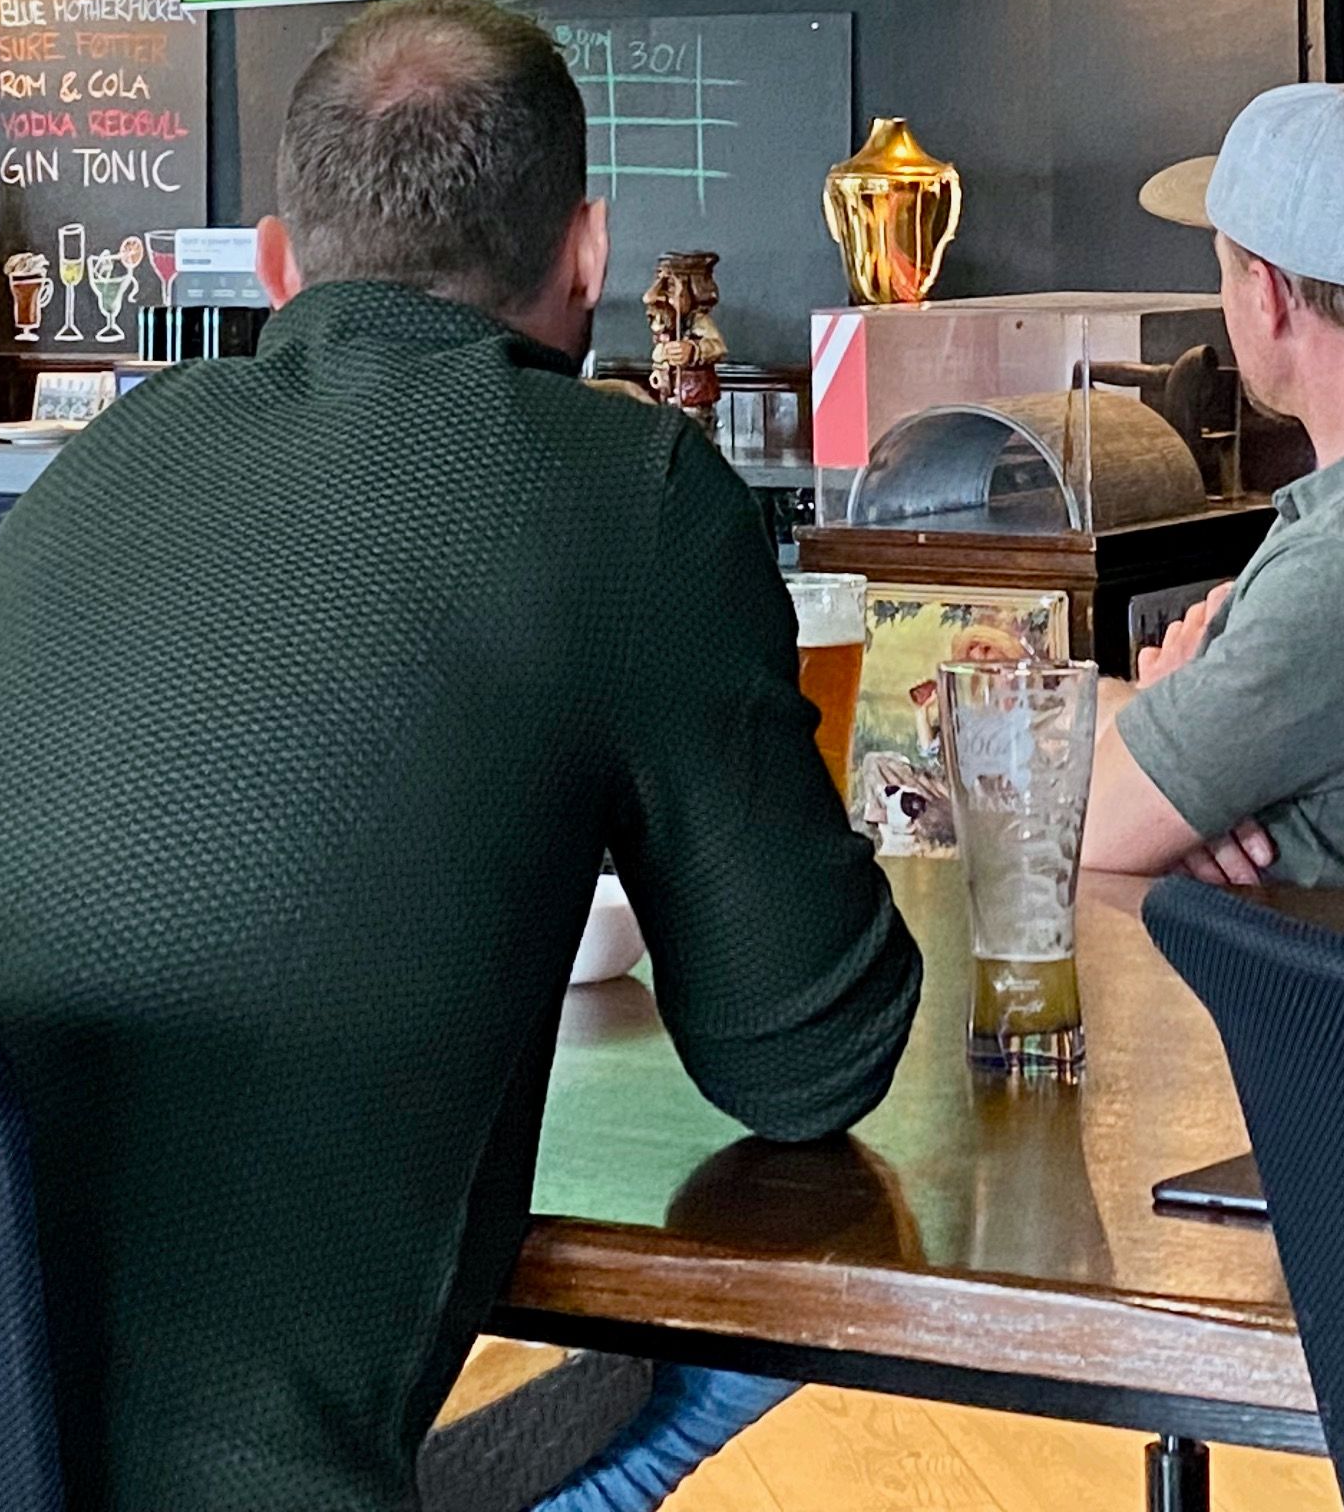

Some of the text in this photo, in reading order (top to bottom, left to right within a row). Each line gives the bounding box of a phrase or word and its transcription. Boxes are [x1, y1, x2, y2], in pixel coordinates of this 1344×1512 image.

[58, 70, 83, 104] &
[87, 66, 152, 101] COLA
[0, 107, 191, 142] VODKA REDBULL
[0, 147, 182, 193] GIN TONIC
